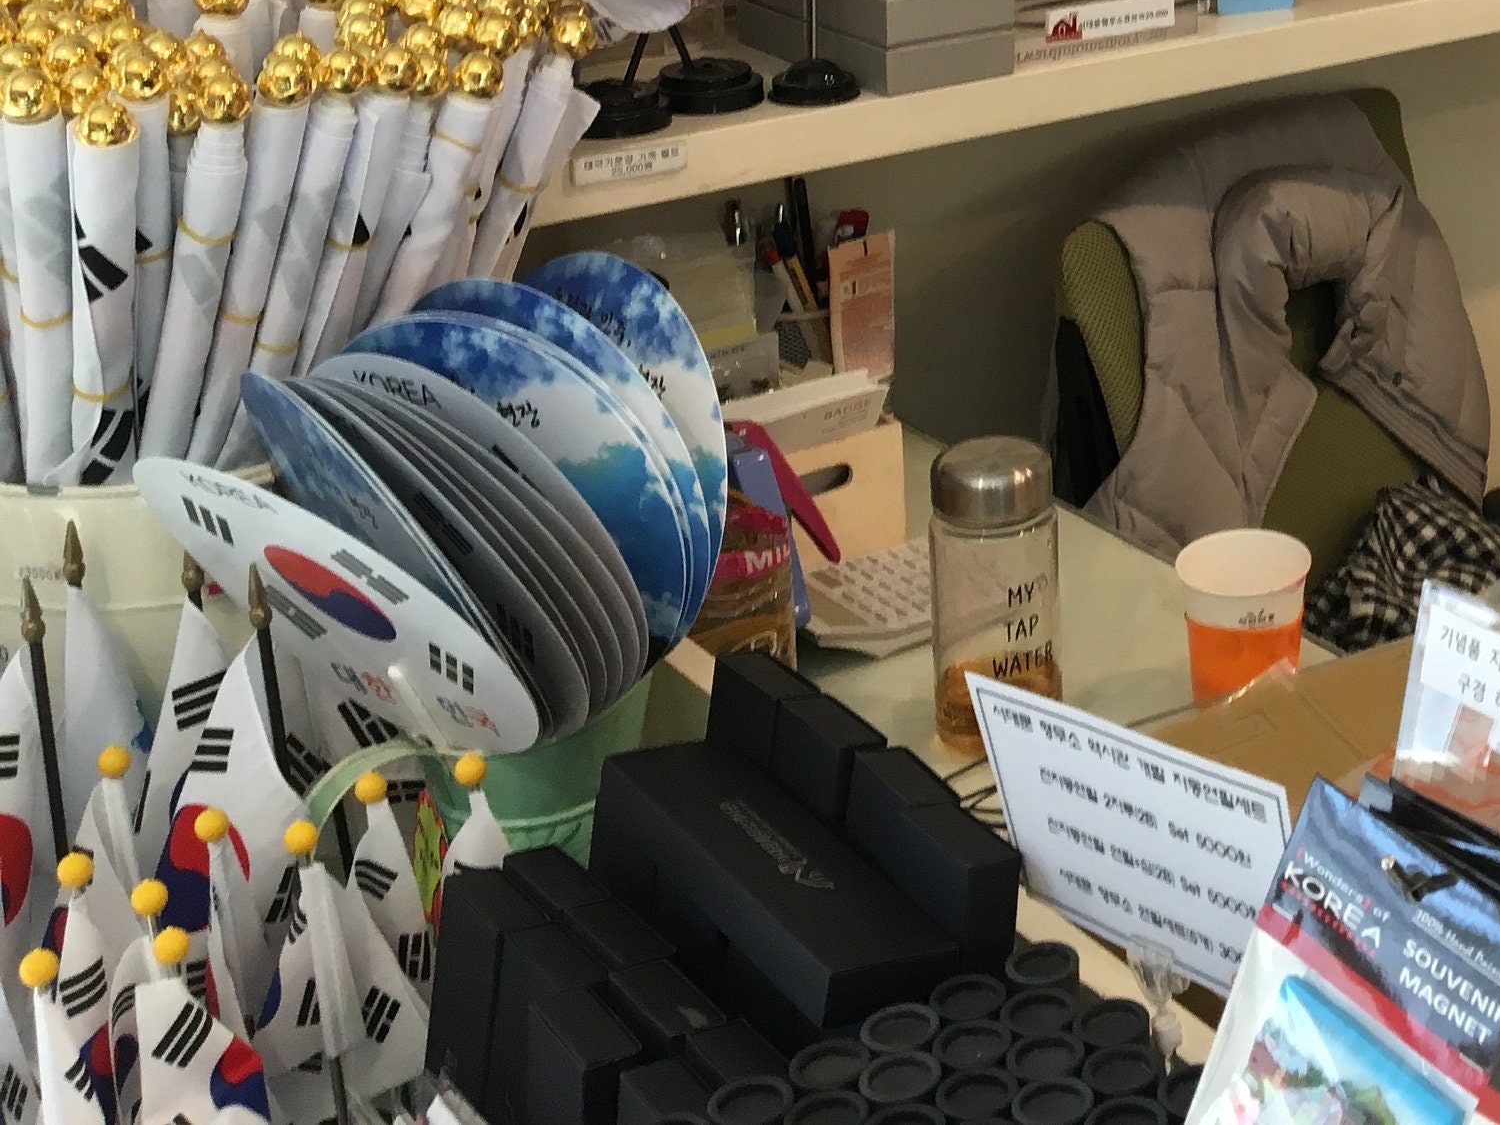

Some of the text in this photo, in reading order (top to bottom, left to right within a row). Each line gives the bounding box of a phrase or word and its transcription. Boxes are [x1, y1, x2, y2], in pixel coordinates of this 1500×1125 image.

[1007, 581, 1034, 608] MY
[1004, 613, 1039, 642] TAP
[992, 639, 1053, 678] WATER
[1458, 673, 1486, 703] 구경
[1284, 861, 1381, 949] KOREA
[1415, 908, 1444, 935] 100%
[1398, 966, 1493, 1046] MAGNET
